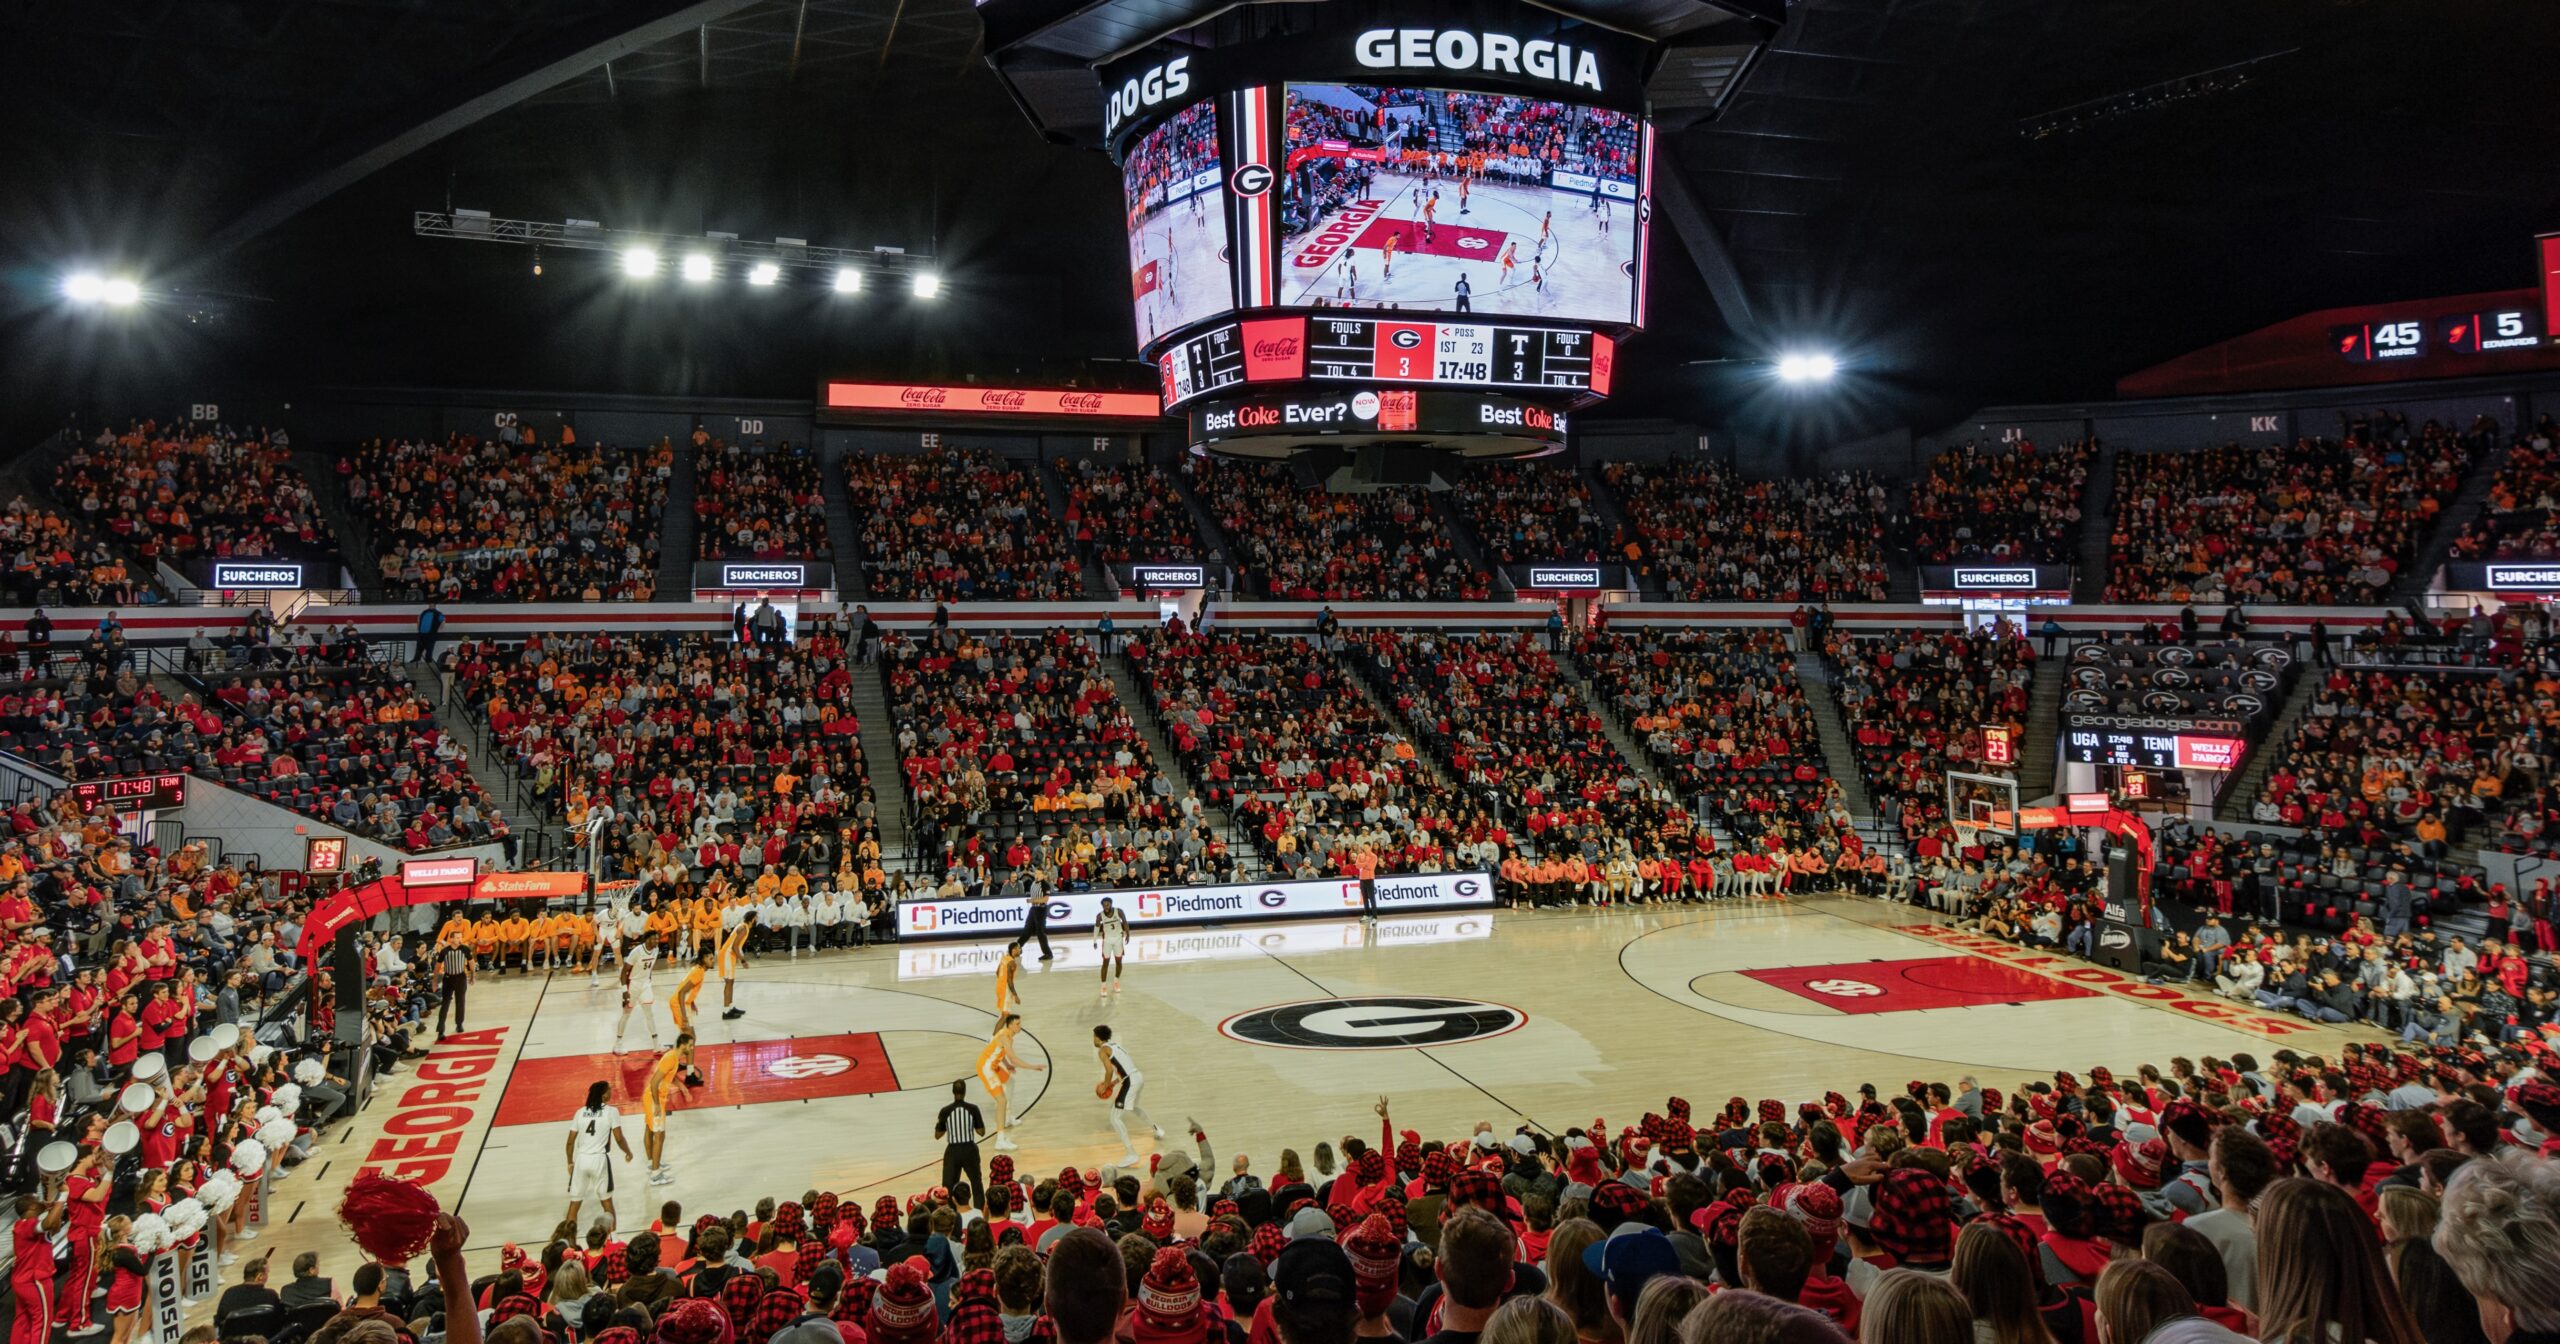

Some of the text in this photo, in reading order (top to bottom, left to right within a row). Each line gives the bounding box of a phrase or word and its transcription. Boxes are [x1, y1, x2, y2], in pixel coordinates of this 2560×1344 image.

[1355, 29, 1602, 92] GEORGIA
[1331, 322, 1361, 334] FOULS
[2497, 312, 2523, 337] 5
[1214, 330, 1229, 344] FOULS
[1340, 334, 1347, 346] 0
[1455, 328, 1474, 338] POSS
[1556, 333, 1580, 345] FOULS
[2374, 322, 2421, 347] 45
[1253, 338, 1298, 358] Coca-Cola
[1441, 341, 1483, 355] 1ST 23
[1511, 335, 1529, 355] T
[2482, 337, 2538, 349] EDWARDS
[1193, 344, 1202, 364] T
[1565, 345, 1571, 356] 0
[2379, 347, 2417, 358] HARRIS
[1351, 366, 1357, 377] 4
[1400, 357, 1410, 377] 3
[1439, 361, 1487, 381] 17:48
[1513, 362, 1523, 381] 3
[1198, 370, 1204, 388] 3
[1571, 376, 1577, 386] 4
[901, 386, 948, 404] Coca-Cola
[980, 389, 1026, 406] Coca-Cola
[1059, 391, 1103, 409] Coca-Cola
[1356, 398, 1376, 406] NOW
[192, 404, 219, 421] BB
[1206, 410, 1236, 431] Best
[1285, 403, 1347, 424] Ever?
[1481, 404, 1522, 425] Best
[1525, 407, 1552, 429] Coke
[741, 420, 764, 434] DD
[2251, 415, 2278, 432] KK
[921, 434, 938, 448] EE
[1093, 437, 1109, 452] FF
[222, 570, 295, 581] SURCHEROS
[730, 570, 798, 580] SURCHEROS
[1144, 572, 1197, 581] URCHEROS
[1536, 573, 1594, 582] SURCHEROS
[1960, 573, 2030, 583] SURCHEROS
[2071, 714, 2241, 731] georgiadogs.com
[2072, 733, 2099, 747] UGA
[2108, 735, 2133, 744] 17:48
[2142, 737, 2173, 750] TENN
[1988, 741, 2007, 761] 23
[2190, 743, 2230, 753] WELLS
[2083, 750, 2091, 761] 3
[2154, 754, 2163, 765] 3
[2192, 753, 2231, 764] FARGO
[113, 780, 151, 796] 17:48
[160, 777, 179, 787] TENN
[176, 791, 182, 801] 3
[86, 800, 92, 811] 3
[315, 853, 336, 867] 23
[409, 866, 469, 878] WELLS FARGO
[1166, 894, 1242, 913] Piedmont
[2104, 903, 2126, 918] Alfa
[941, 906, 1024, 926] Piedmont
[2100, 933, 2130, 947] LIBMAN
[1892, 924, 2320, 1035] BULLDOGS
[352, 1026, 510, 1187] GEORGIA
[585, 1120, 596, 1136] 4
[192, 1224, 210, 1296] OISE
[157, 1256, 180, 1344] NOISE
[1145, 1298, 1194, 1311] BULLDOGS
